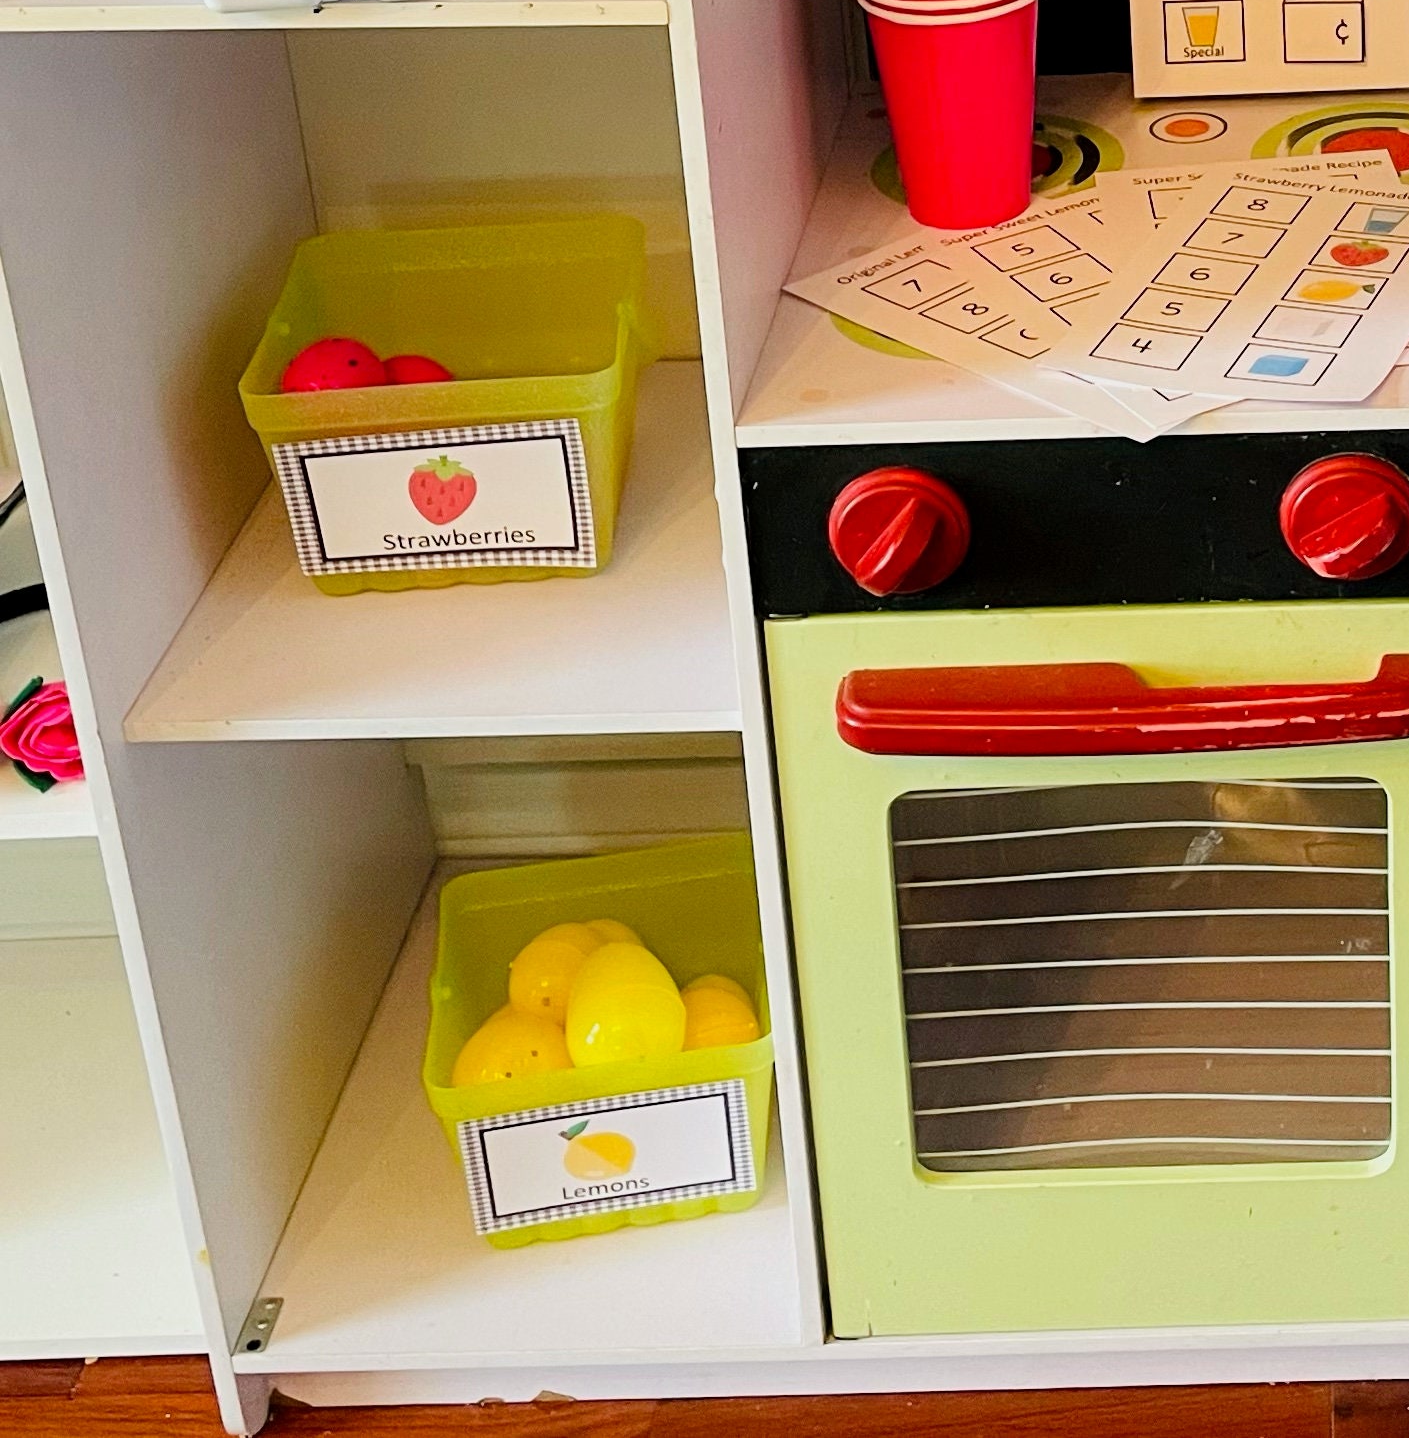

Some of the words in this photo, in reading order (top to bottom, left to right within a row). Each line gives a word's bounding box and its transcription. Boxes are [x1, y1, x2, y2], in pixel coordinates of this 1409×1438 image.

[1183, 46, 1225, 61] Special
[1132, 175, 1182, 186] Super
[1326, 159, 1383, 173] Recipe
[1234, 172, 1325, 192] Strawberry
[1247, 198, 1269, 211] 8
[940, 227, 990, 247] Super
[991, 213, 1042, 232] Sweet
[1045, 197, 1100, 217] Lemon
[1221, 232, 1244, 244] 7
[1011, 242, 1035, 257] 5
[837, 255, 897, 286] Original
[1189, 267, 1211, 281] 6
[902, 279, 922, 293] 7
[1049, 272, 1074, 286] 6
[962, 302, 989, 317] 8
[1160, 301, 1184, 316] 5
[1131, 338, 1153, 353] 4
[383, 526, 536, 550] Strawberries
[563, 1177, 650, 1200] Lemons
